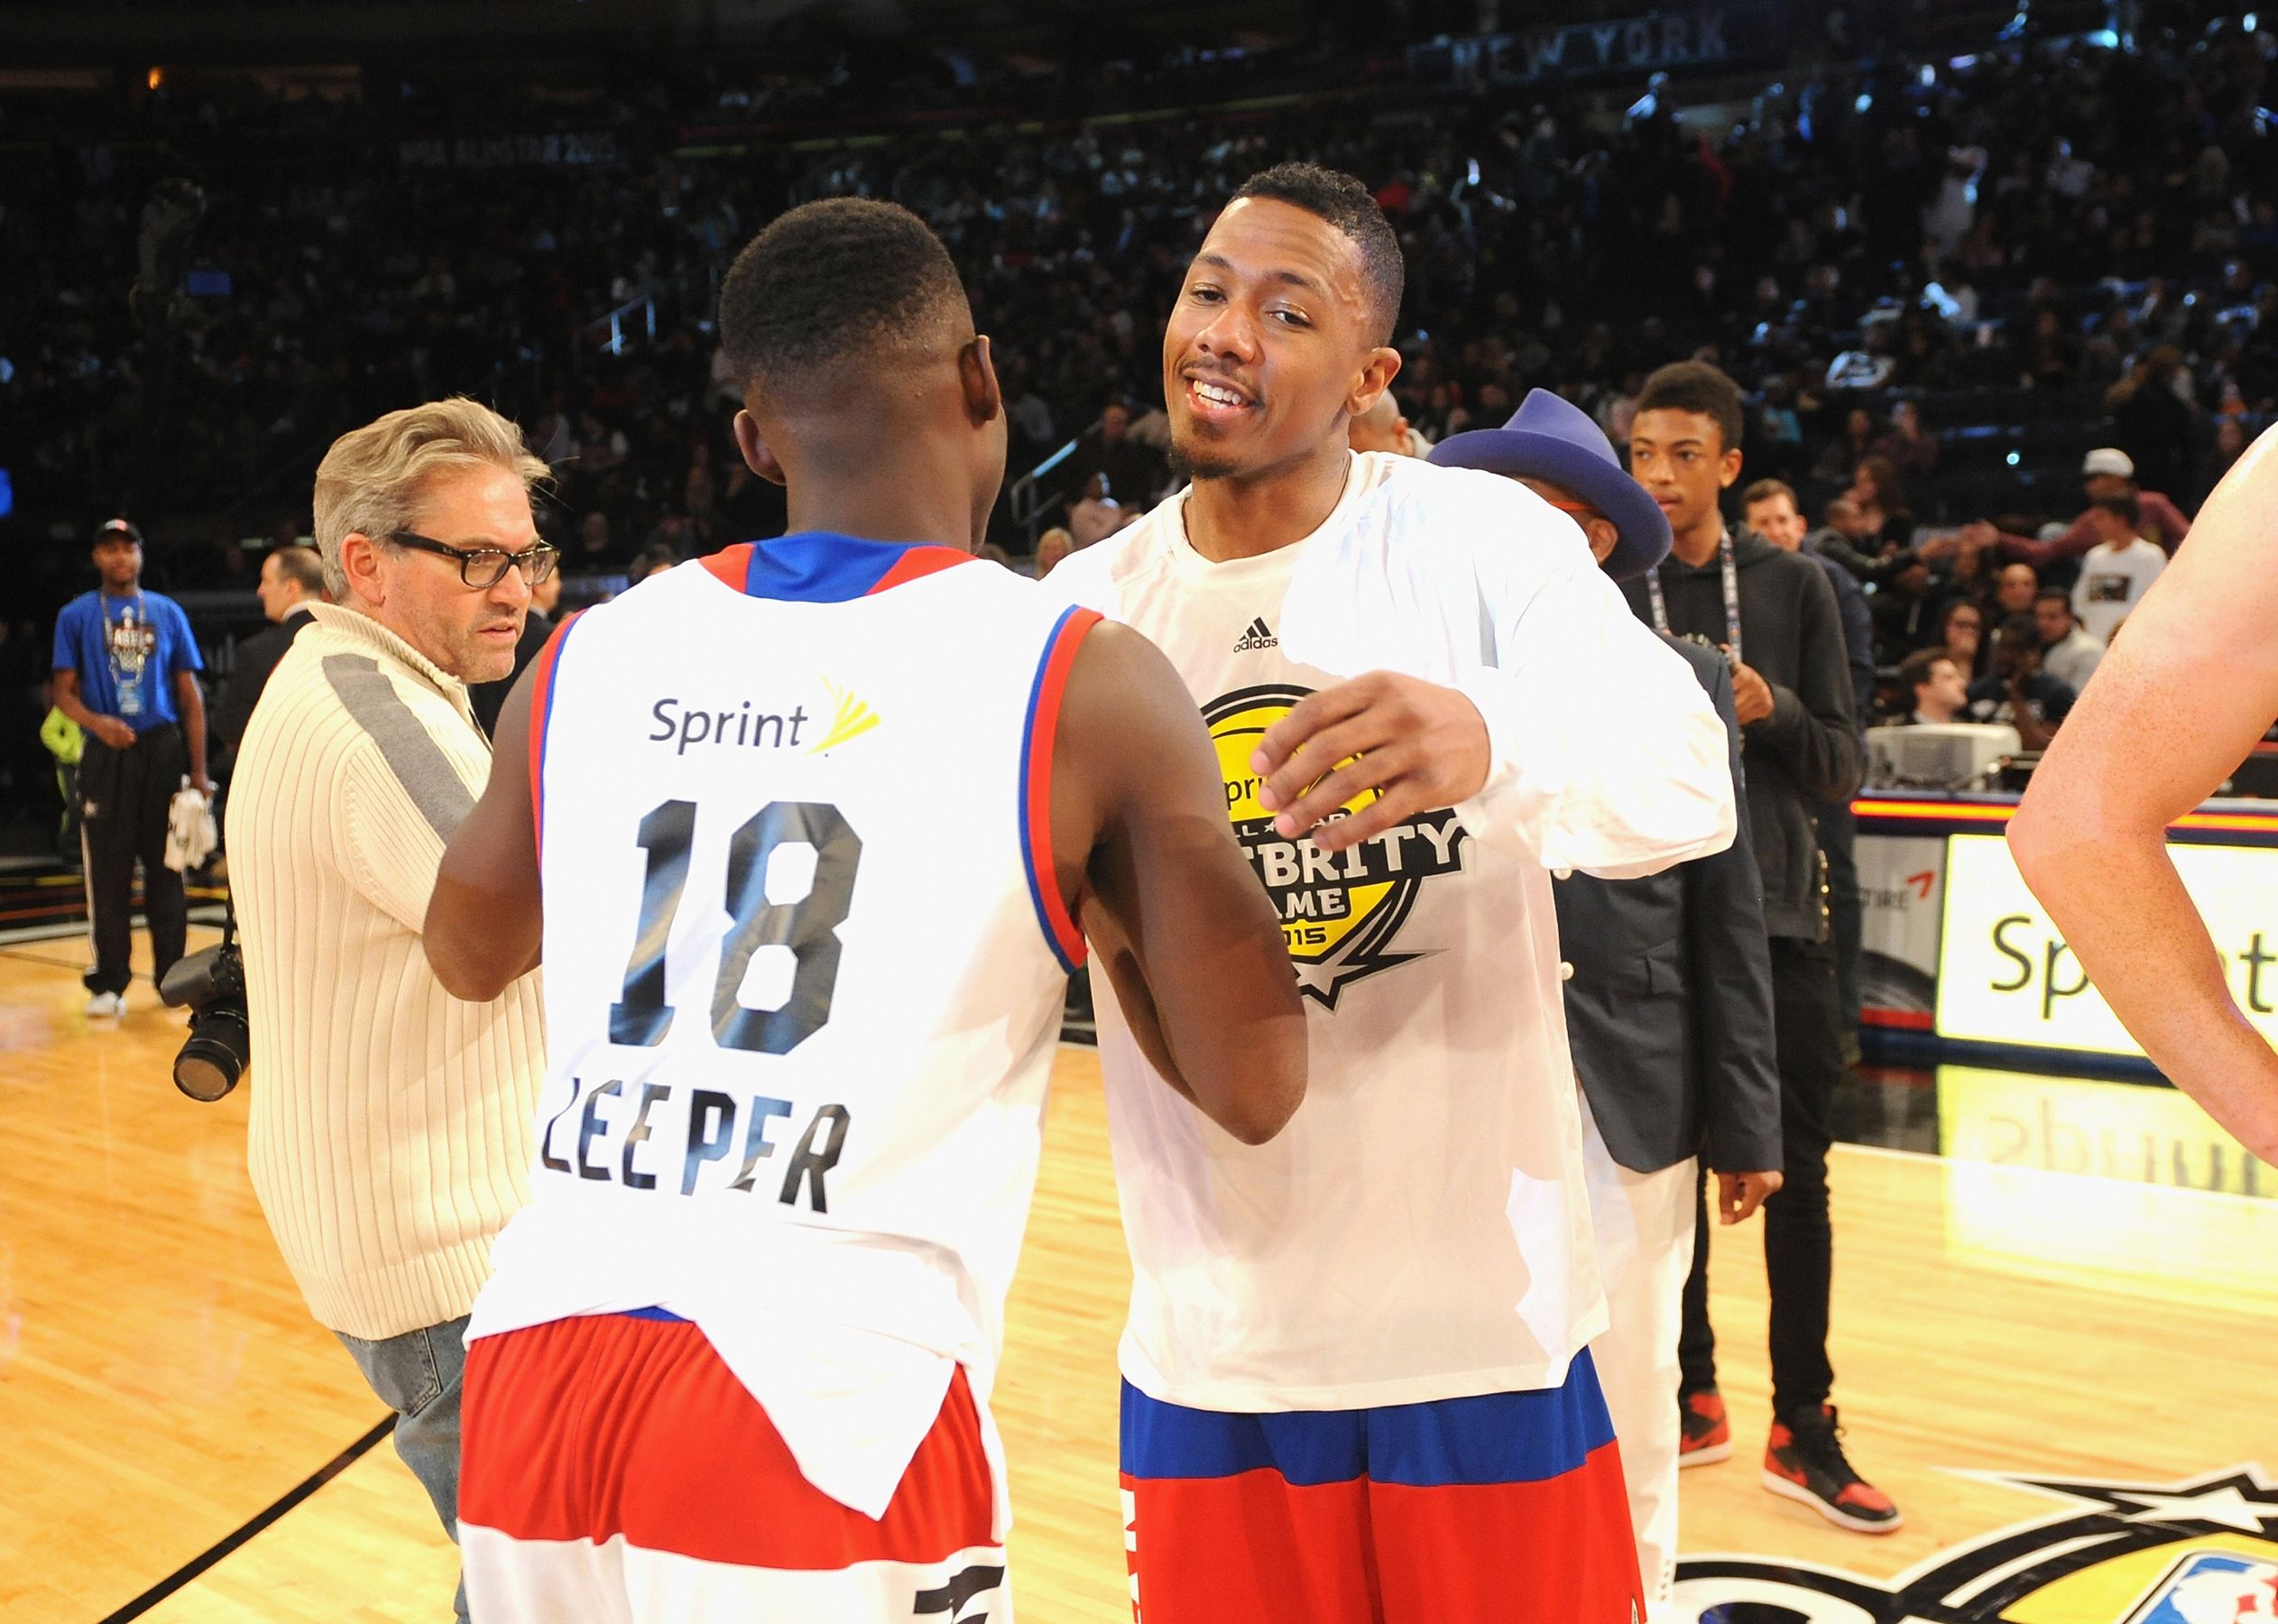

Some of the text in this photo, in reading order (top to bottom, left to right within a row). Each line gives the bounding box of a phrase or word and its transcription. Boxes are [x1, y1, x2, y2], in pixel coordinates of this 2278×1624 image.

[1452, 14, 1727, 88] NEW YORK
[1233, 635, 1278, 653] adidas
[649, 698, 808, 756] Sprint
[1240, 817, 1462, 888] BRITY
[608, 798, 863, 1056] 18
[1991, 915, 2277, 1020] Spt
[541, 1077, 851, 1214] LEEPER
